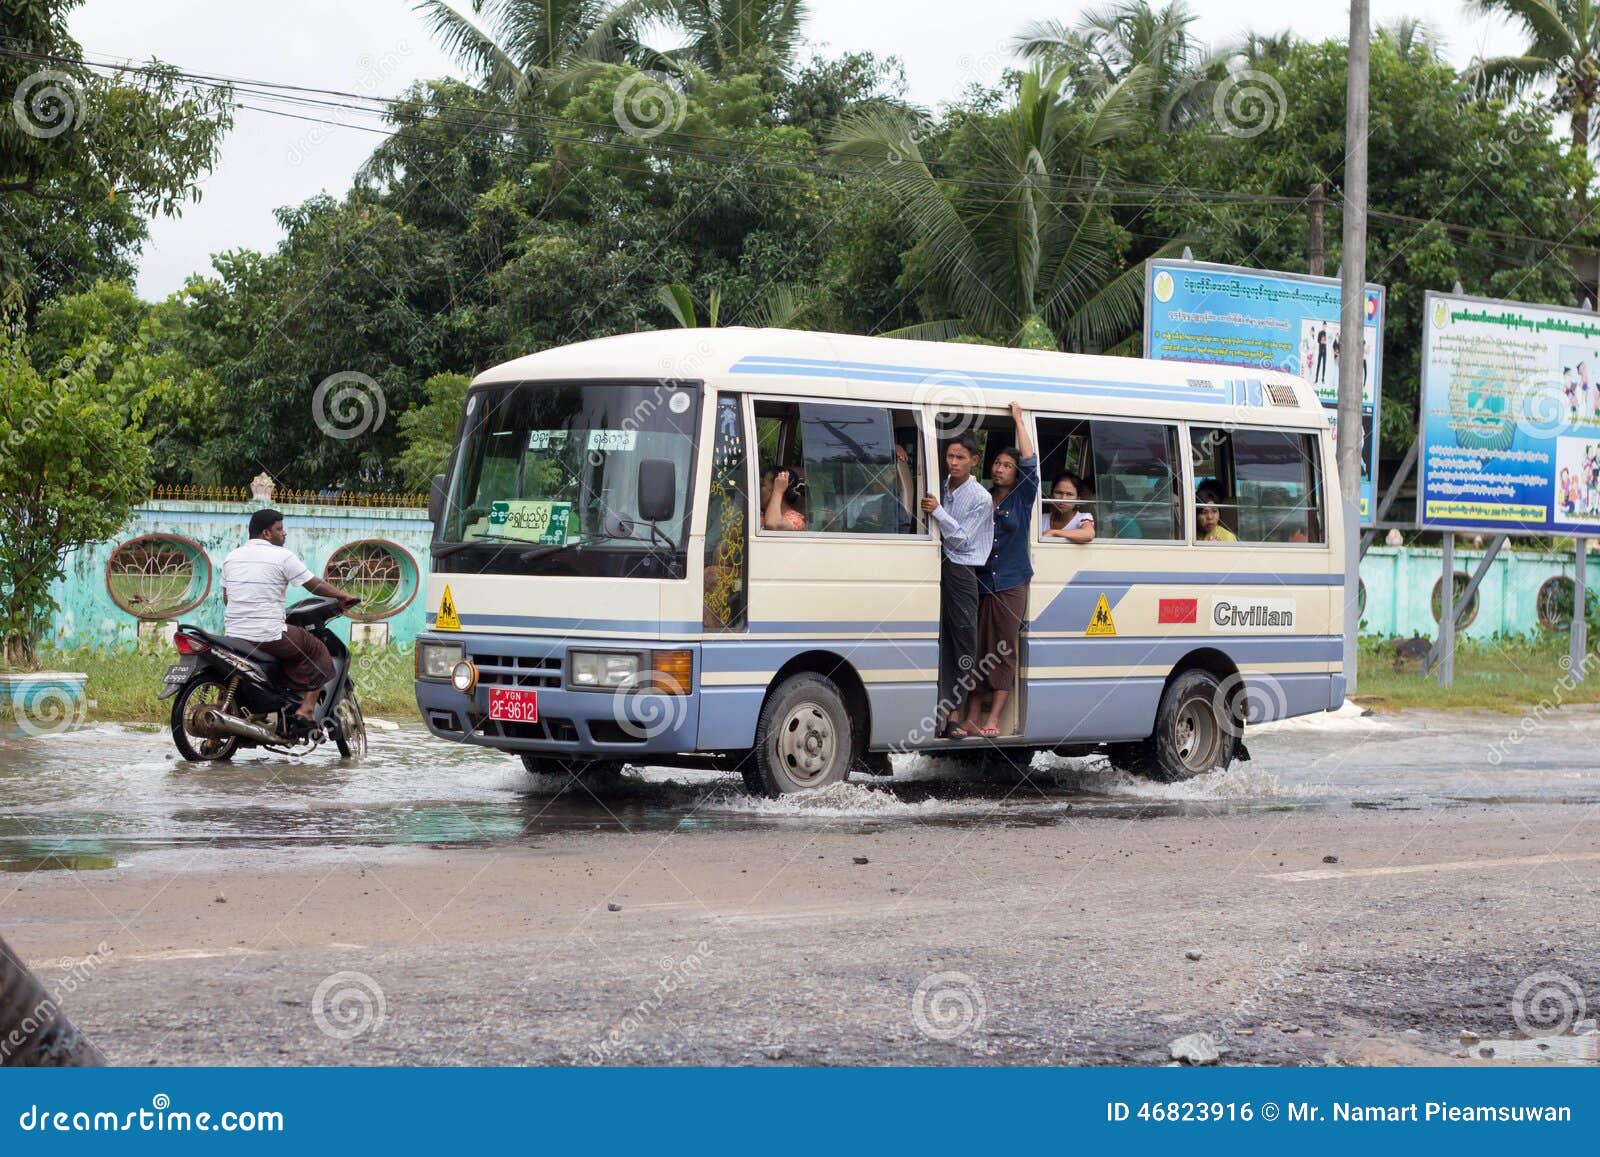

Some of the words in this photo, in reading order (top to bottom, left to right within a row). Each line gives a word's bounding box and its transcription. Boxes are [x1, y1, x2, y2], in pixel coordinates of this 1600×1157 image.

[1213, 601, 1293, 627] Civilian
[505, 690, 521, 701] YGN
[492, 700, 535, 720] 2F-9612
